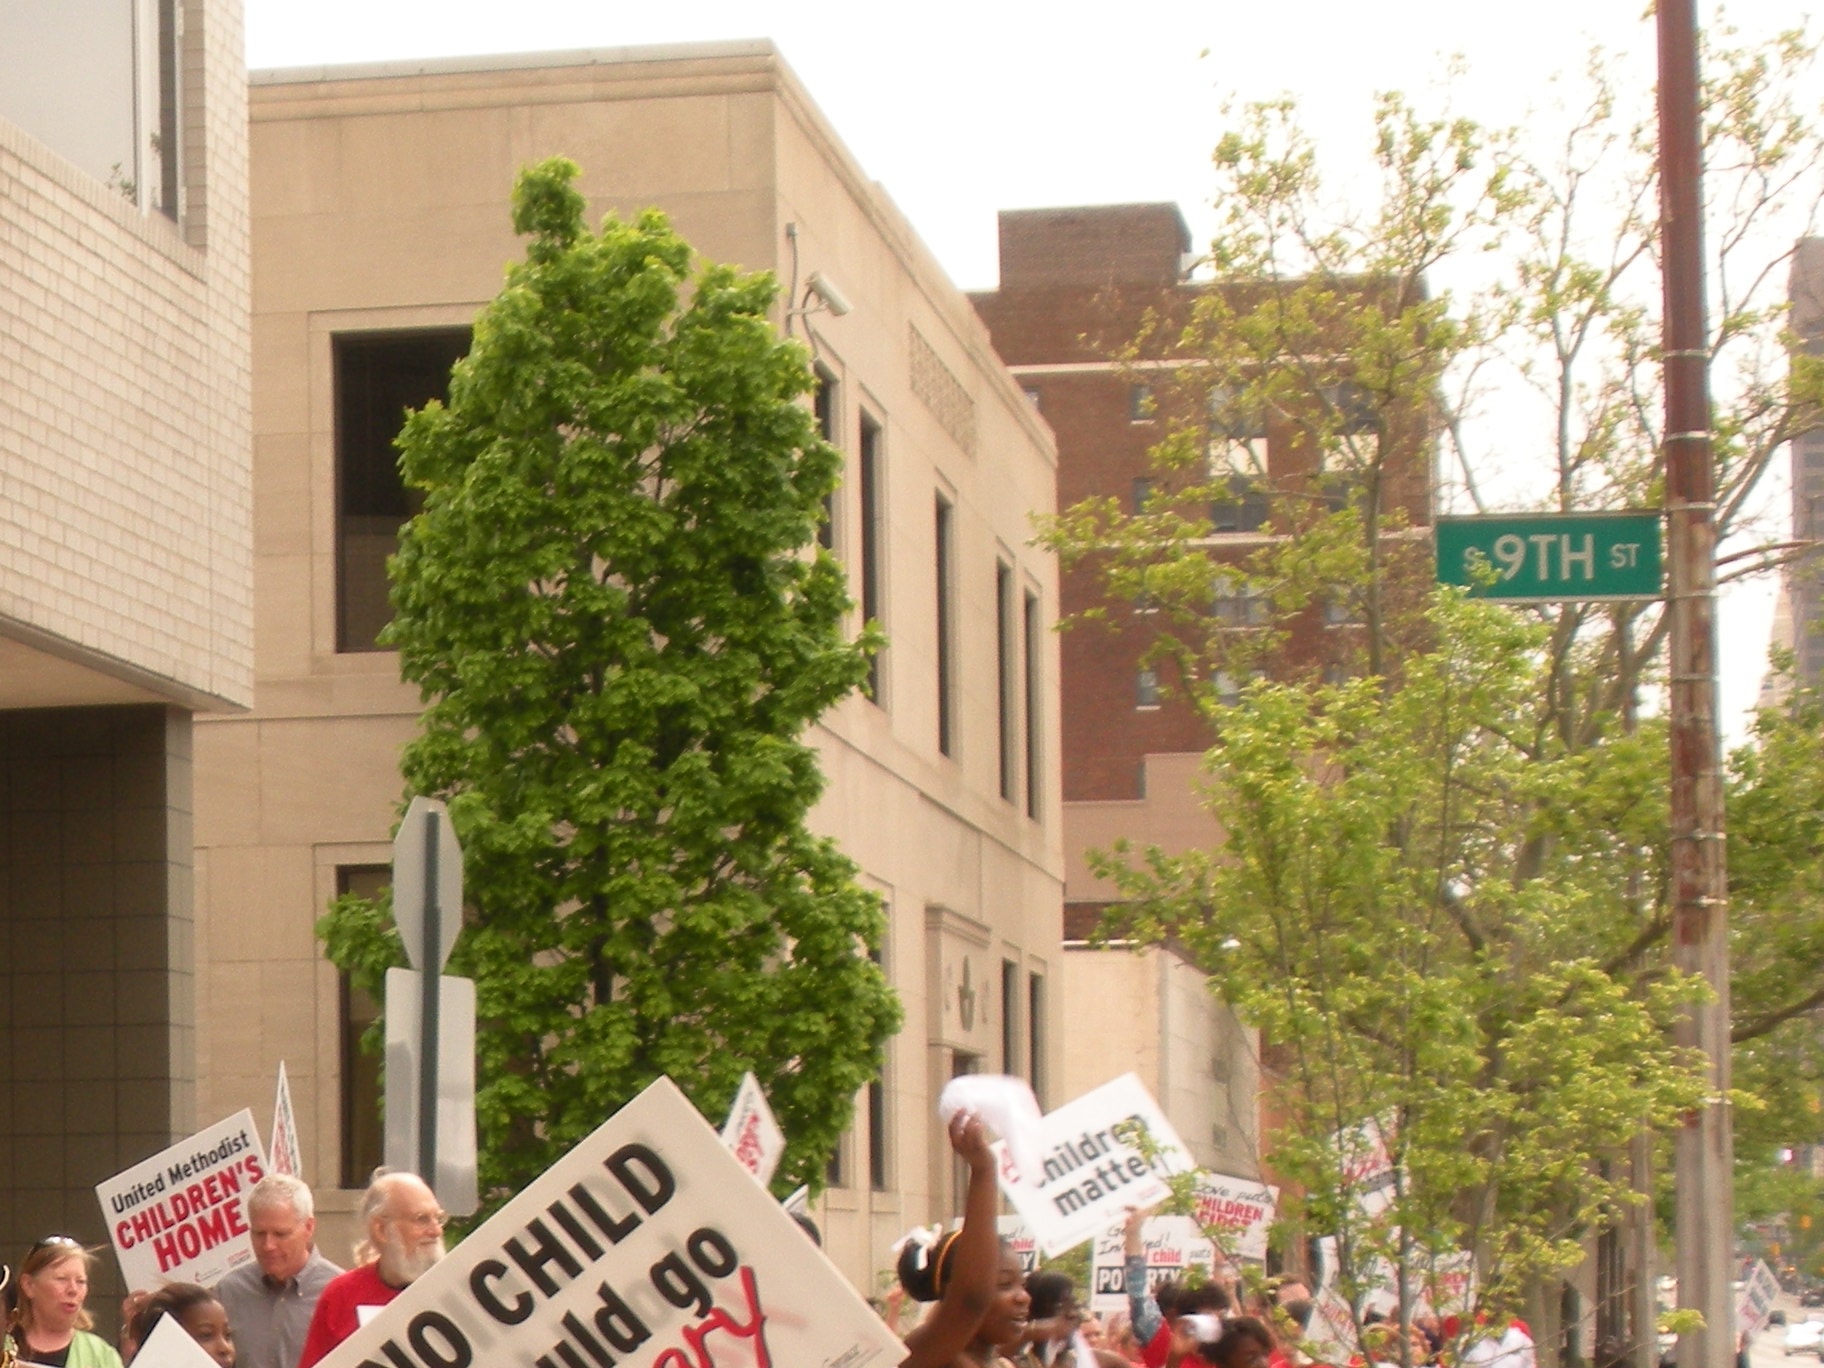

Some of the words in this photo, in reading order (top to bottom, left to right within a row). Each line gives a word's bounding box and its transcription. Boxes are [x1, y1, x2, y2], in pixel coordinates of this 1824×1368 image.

[1493, 533, 1594, 581] 9TH
[1610, 543, 1641, 569] ST
[110, 1174, 166, 1214] United
[167, 1129, 252, 1184] Methodist
[116, 1154, 265, 1251] CHILDREN'S
[152, 1199, 249, 1274] HOME
[469, 1141, 677, 1327] CHILD
[648, 1225, 740, 1319] go
